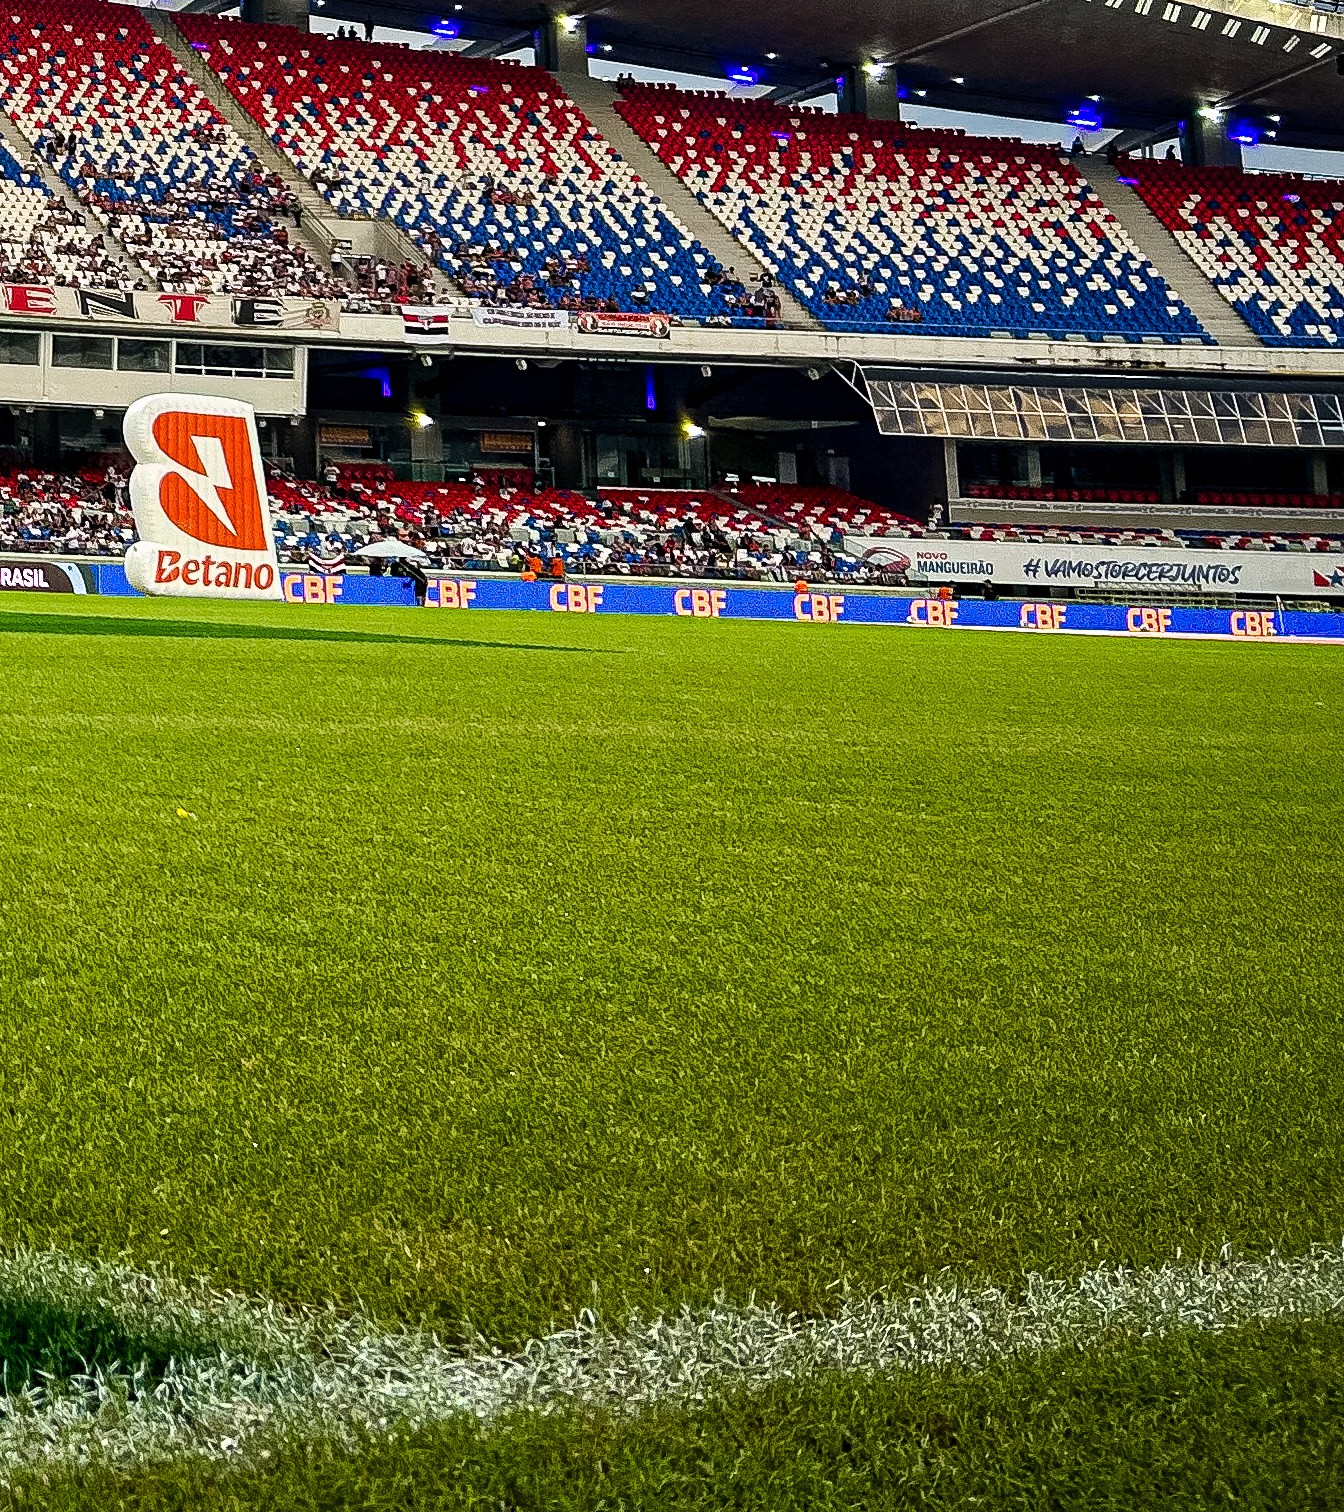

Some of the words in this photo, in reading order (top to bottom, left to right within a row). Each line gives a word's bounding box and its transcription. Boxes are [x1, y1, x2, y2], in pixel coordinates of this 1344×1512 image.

[917, 551, 947, 560] NOVO
[917, 560, 994, 576] MANGUEIRÃO
[155, 550, 274, 590] Betano
[283, 574, 343, 604] CBF
[550, 584, 604, 613] CBF
[674, 589, 727, 617] CBF
[794, 593, 844, 622] CBF
[909, 599, 958, 626] CBF
[1020, 603, 1067, 629] CBF
[1127, 607, 1171, 632] CBF
[1231, 611, 1275, 636] CBF
